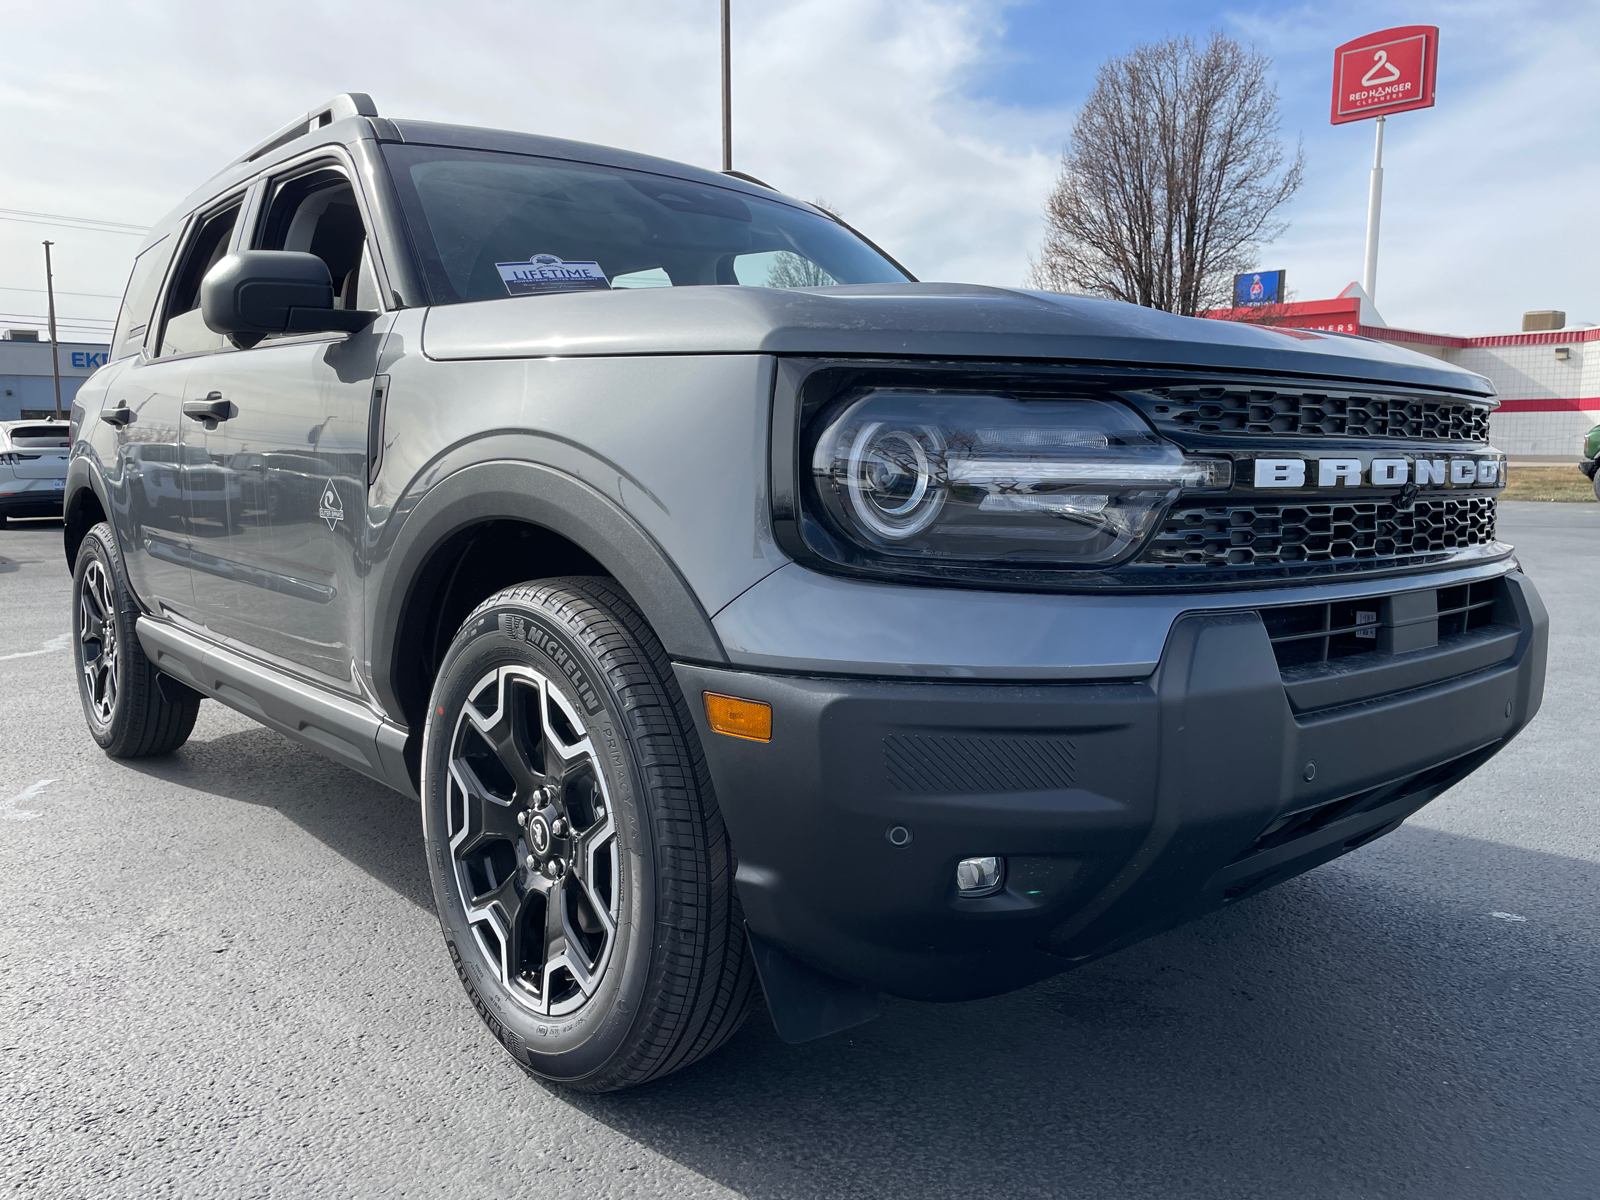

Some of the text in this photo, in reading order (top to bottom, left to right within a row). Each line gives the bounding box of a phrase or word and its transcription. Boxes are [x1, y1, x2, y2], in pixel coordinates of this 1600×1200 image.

[1349, 91, 1368, 102] RED
[1356, 92, 1403, 106] CLEANERS
[513, 269, 593, 280] LIFETIME
[1254, 458, 1498, 488] BRONCO
[527, 626, 599, 710] MICHELIN
[602, 728, 633, 808] PRIMACY
